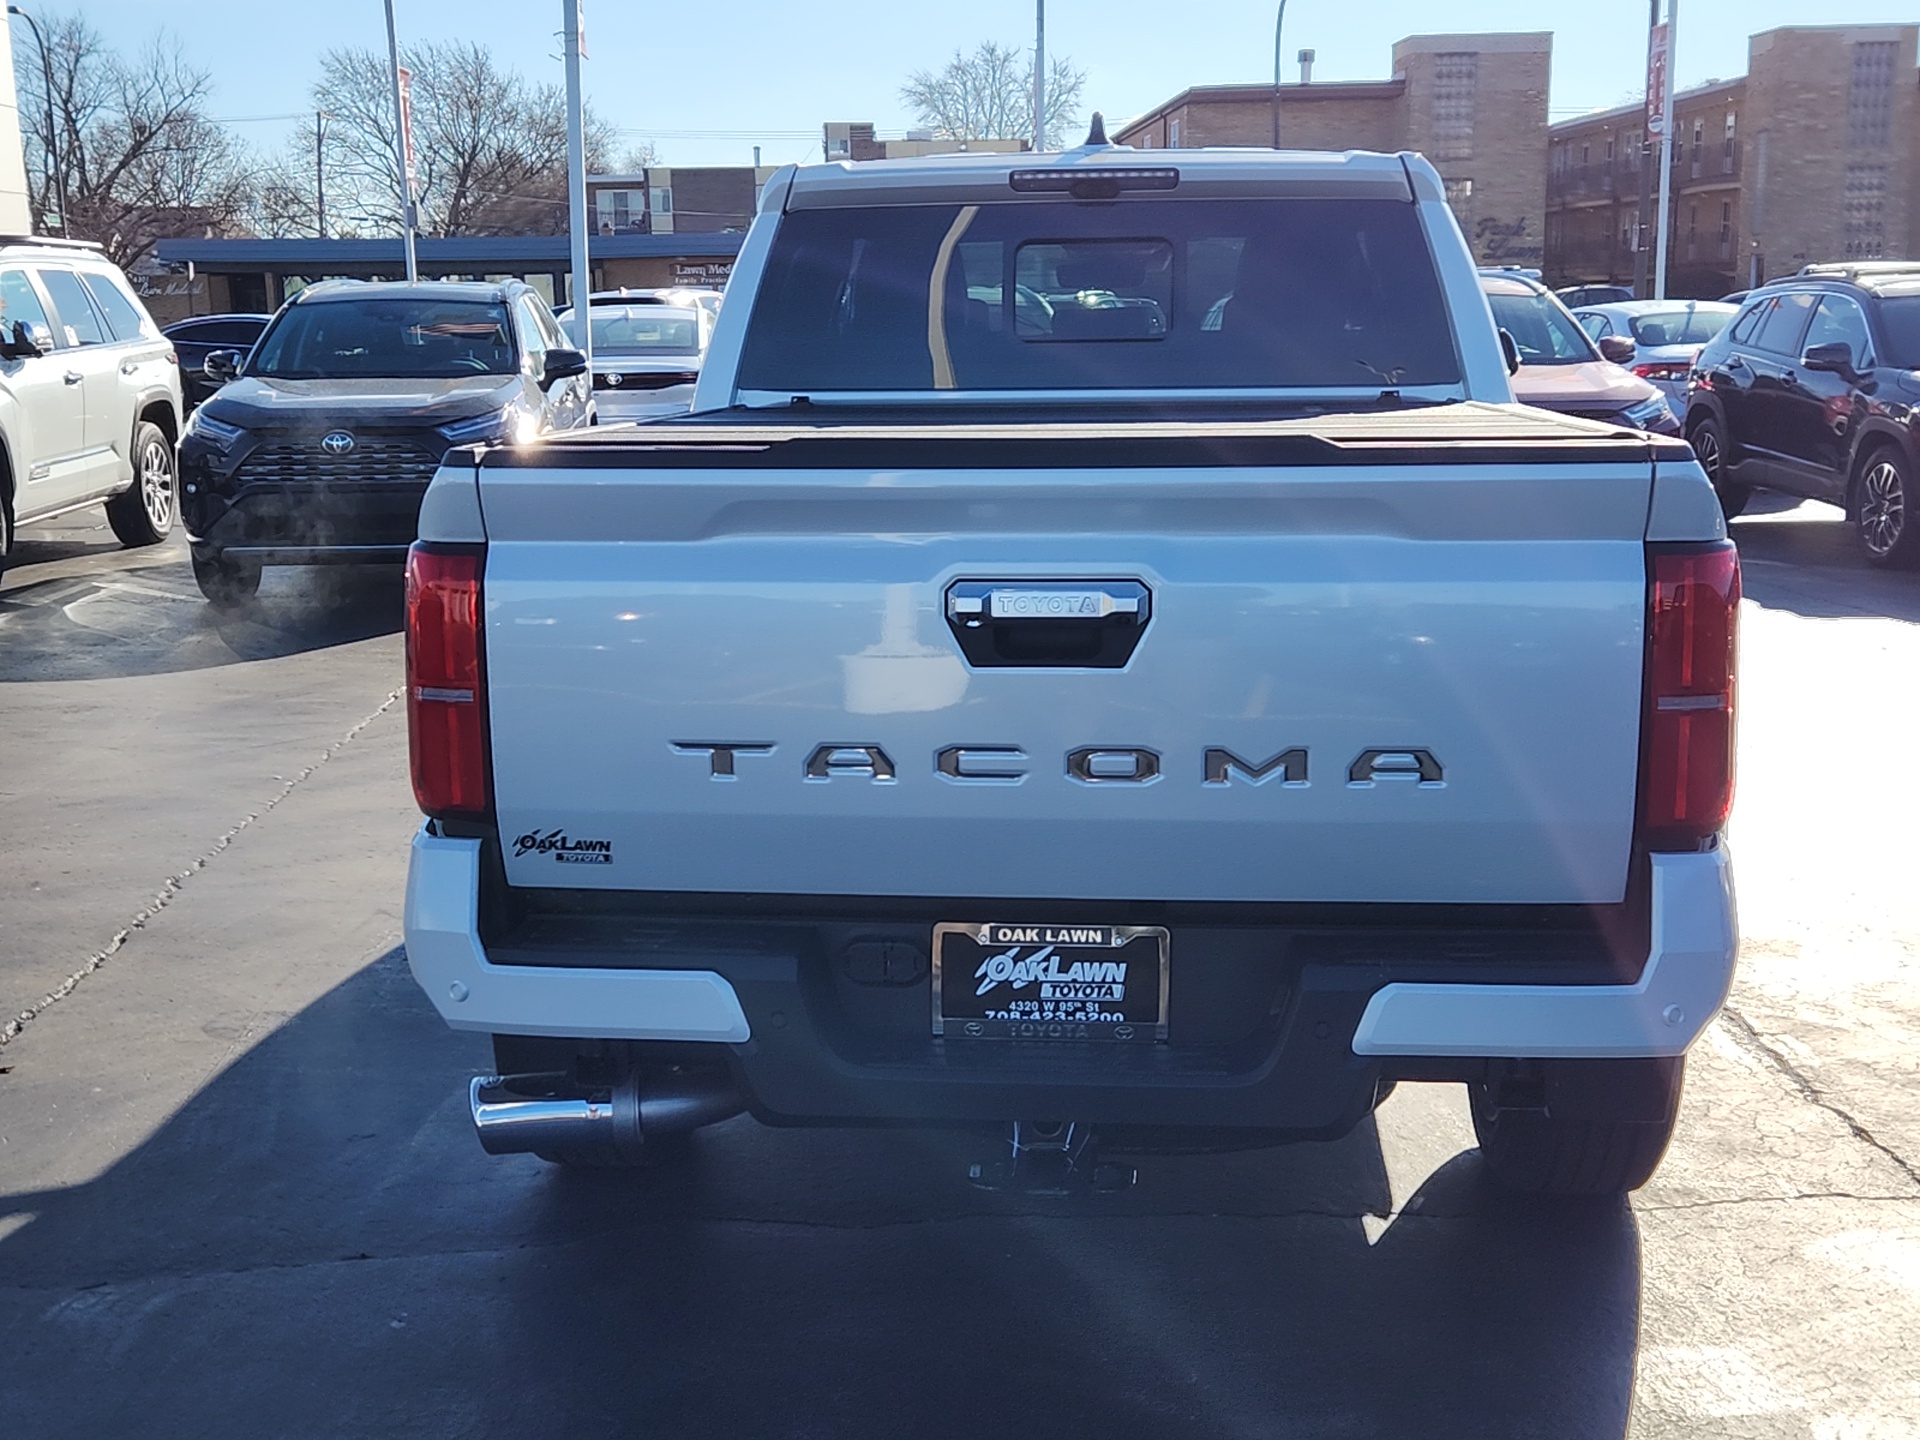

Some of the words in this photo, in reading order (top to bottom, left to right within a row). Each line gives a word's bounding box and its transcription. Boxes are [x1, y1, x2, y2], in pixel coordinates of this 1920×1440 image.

[676, 264, 706, 276] Lawn
[998, 596, 1096, 613] TOYOTA
[667, 740, 1448, 790] TACOMA
[562, 853, 604, 862] TOYOTA
[997, 928, 1040, 942] OAK
[1045, 929, 1103, 943] LAWN
[1050, 984, 1114, 998] TOYOTA
[1008, 1000, 1039, 1012] 4320
[1042, 1001, 1056, 1012] W
[1085, 1001, 1100, 1012] St
[985, 1010, 1124, 1021] 708-423-5200
[1007, 1023, 1089, 1037] TOYOTA
